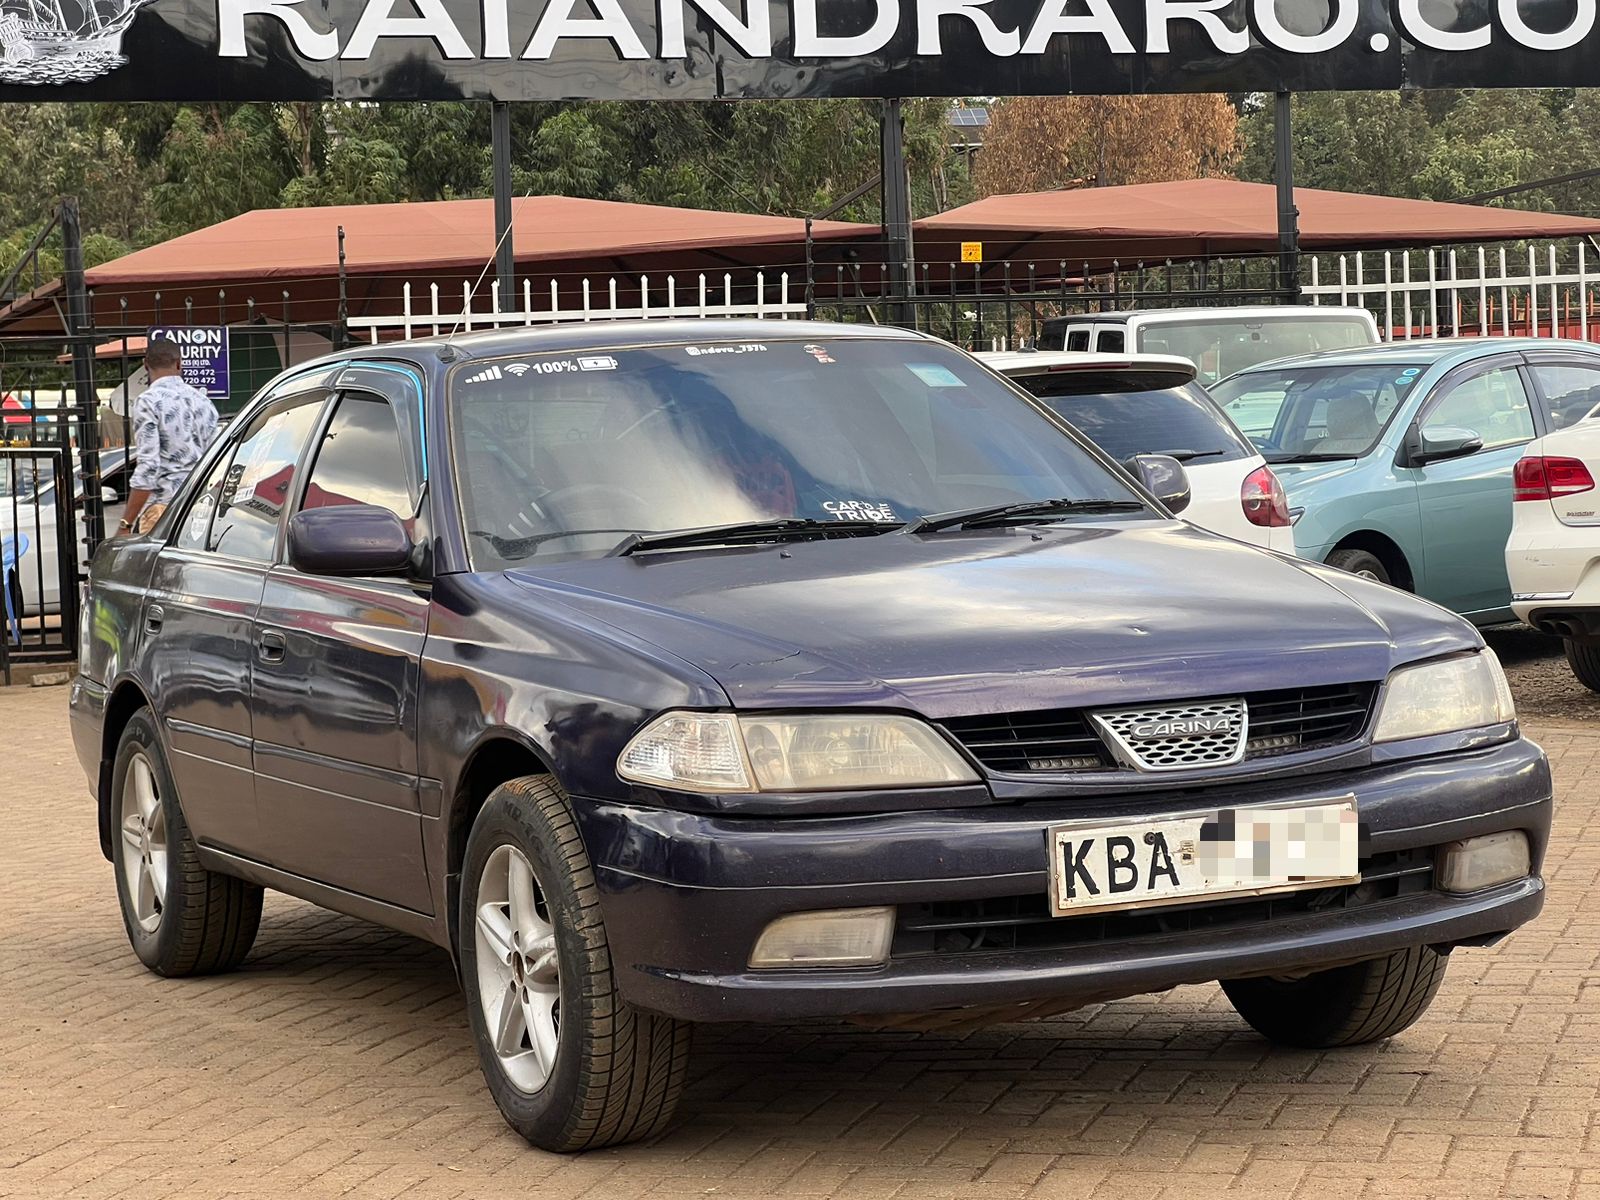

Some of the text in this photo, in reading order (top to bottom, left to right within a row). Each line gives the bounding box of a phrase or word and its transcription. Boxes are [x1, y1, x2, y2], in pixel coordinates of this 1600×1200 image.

[180, 345, 221, 358] URITY
[532, 360, 578, 374] 100%
[1134, 718, 1229, 736] CARINA
[1063, 831, 1180, 899] KBA
